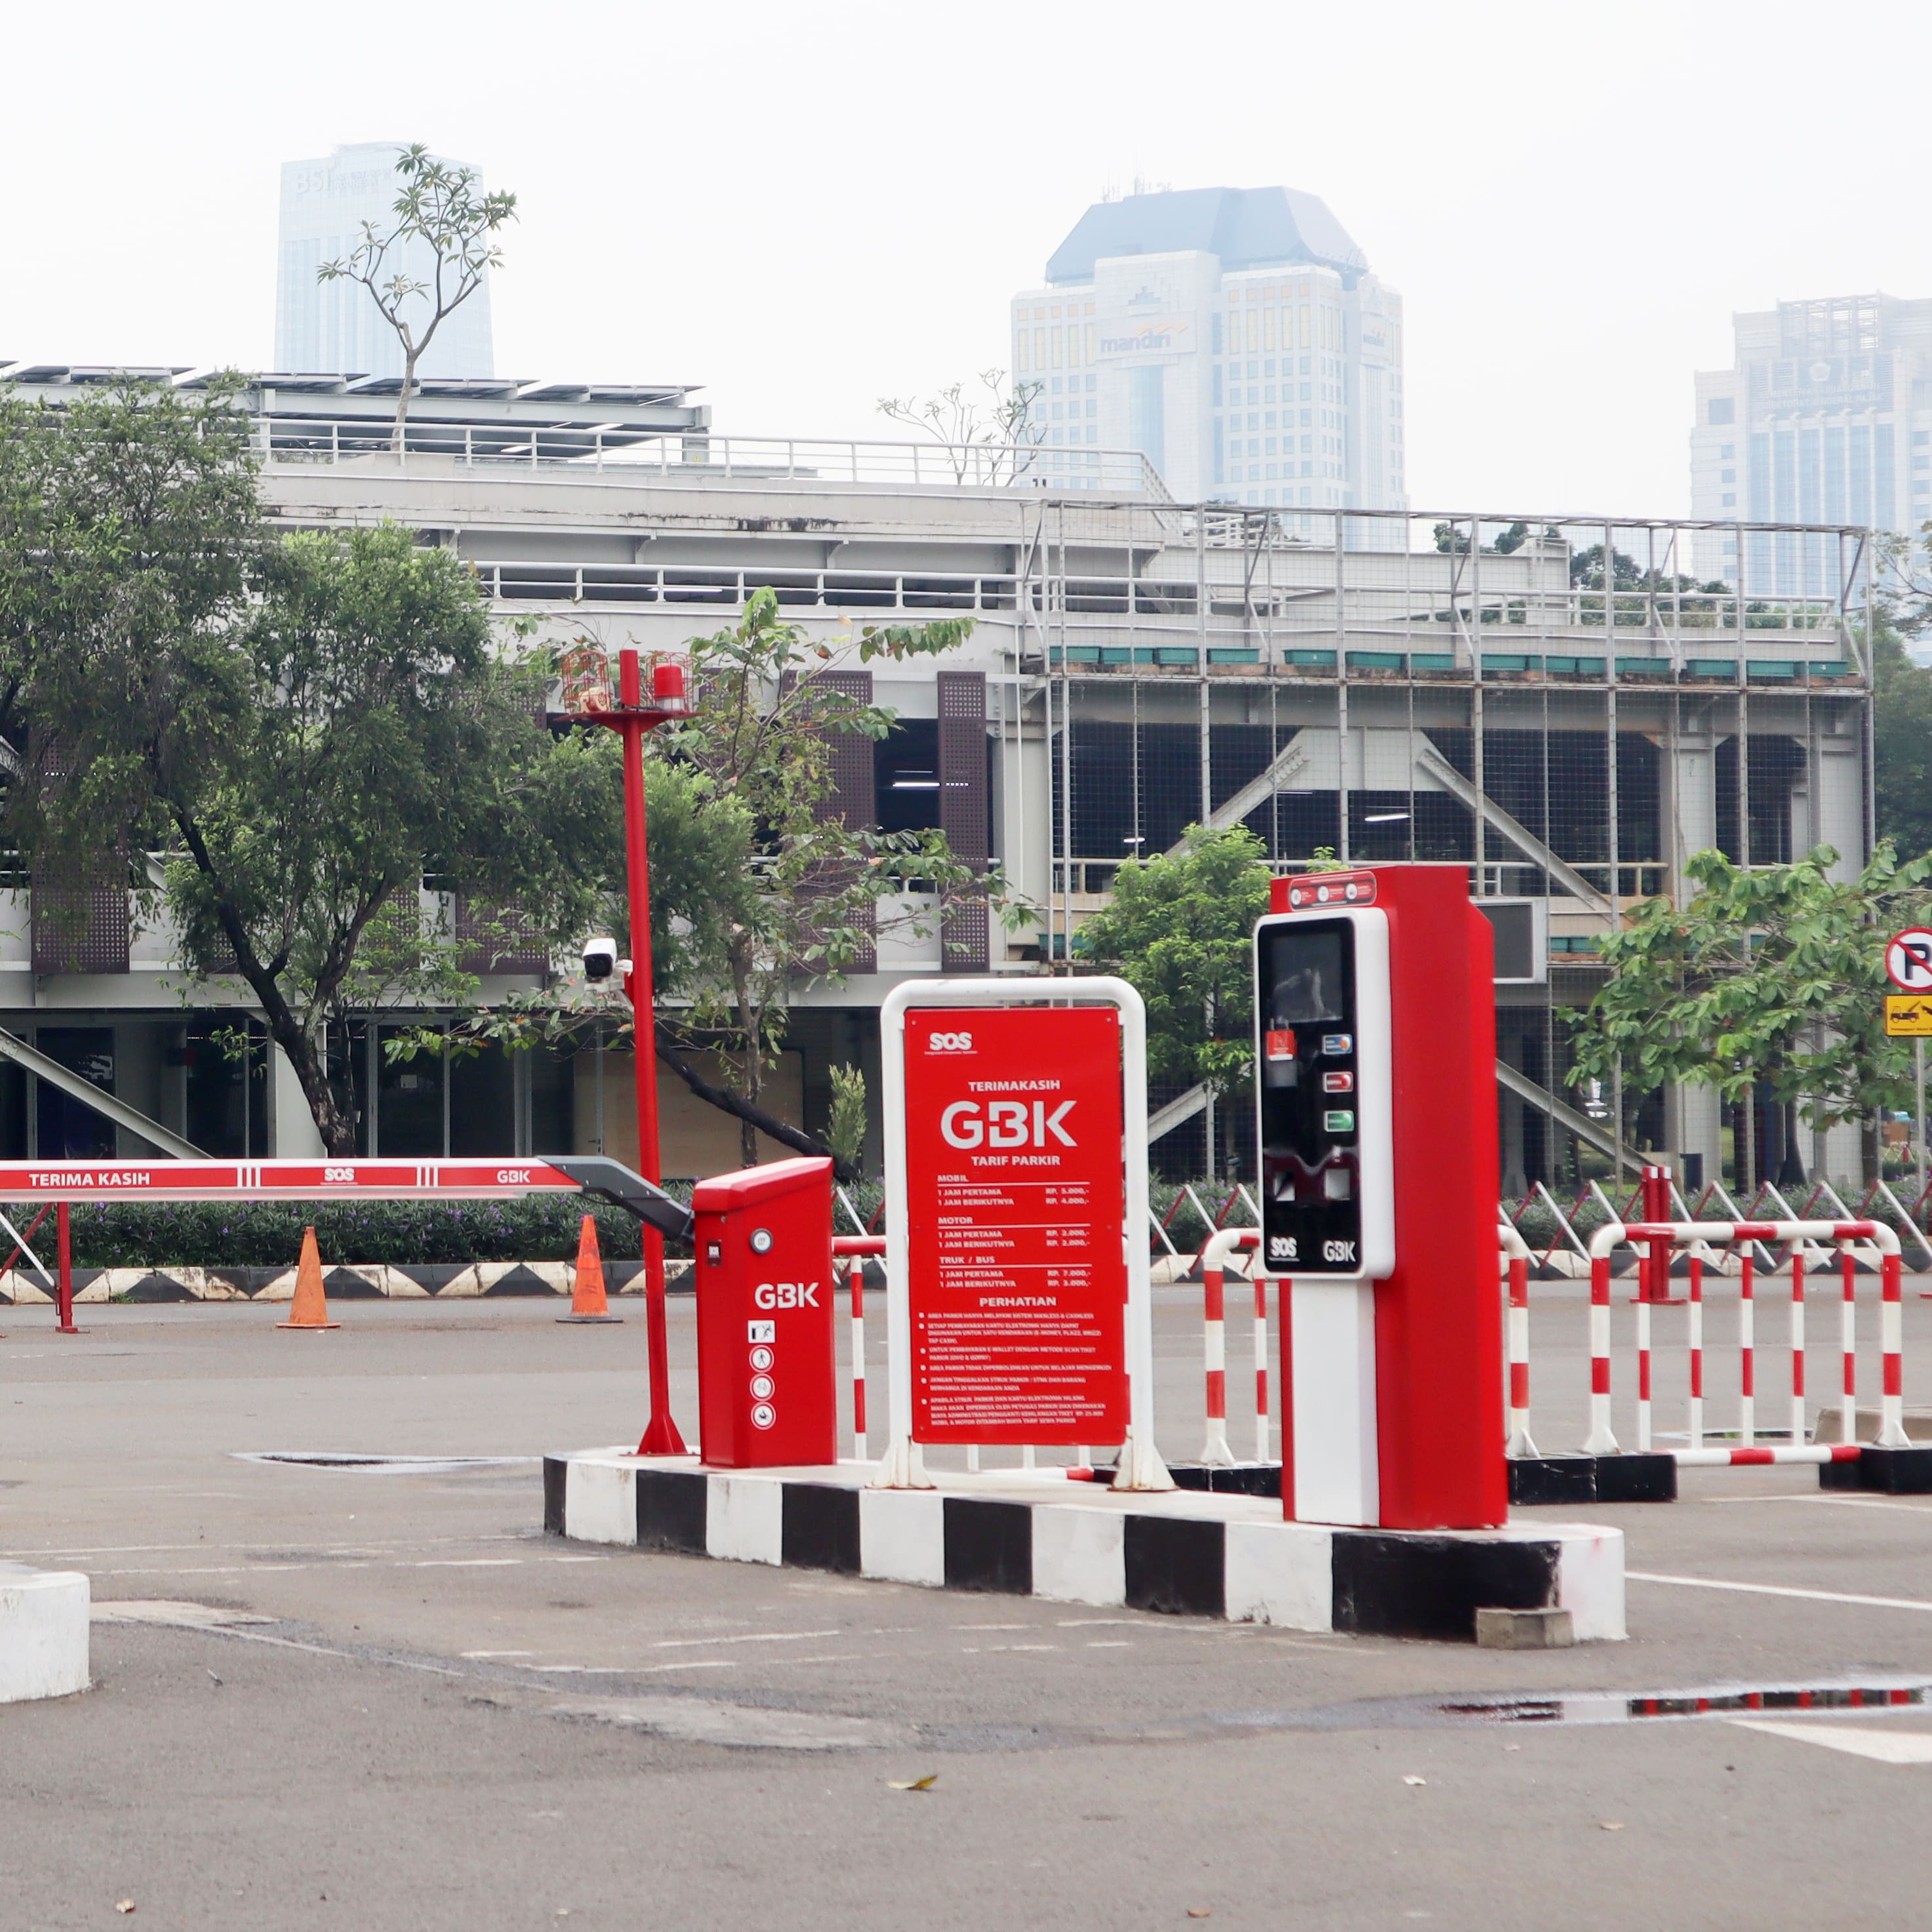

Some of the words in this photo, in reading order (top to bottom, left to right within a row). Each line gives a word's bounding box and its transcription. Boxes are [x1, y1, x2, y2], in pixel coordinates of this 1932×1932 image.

[1101, 331, 1171, 352] mandiri
[930, 1032, 972, 1051] SOS
[968, 1080, 1060, 1092] TERIMAKASIH
[940, 1100, 1077, 1150] GBK
[971, 1156, 1009, 1167] TARIF
[1012, 1156, 1060, 1166] PARKIR
[29, 1173, 94, 1186] TERIMA
[98, 1173, 150, 1185] KASIH
[325, 1167, 355, 1181] SOS
[496, 1170, 530, 1183] GBK
[1270, 1237, 1297, 1257] SOS
[1323, 1240, 1356, 1262] GBK
[754, 1282, 820, 1310] GBK
[979, 1297, 1057, 1307] PERHATIAN
